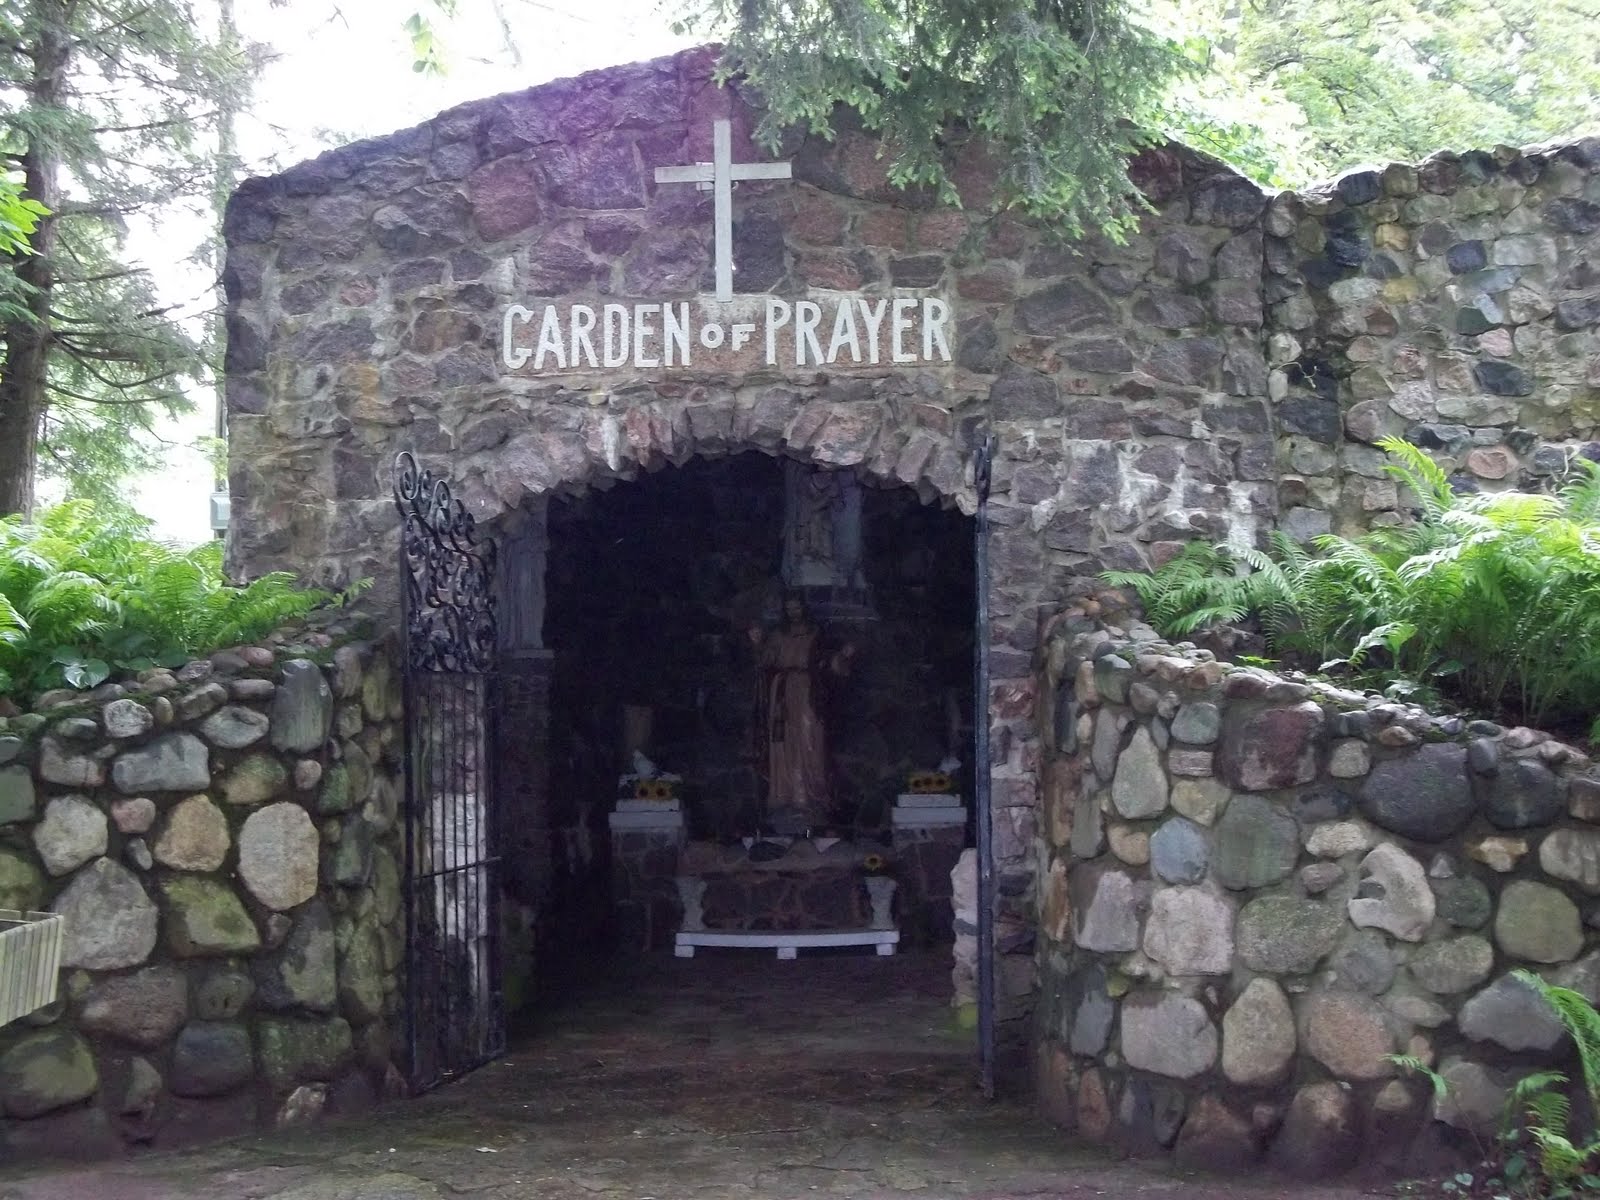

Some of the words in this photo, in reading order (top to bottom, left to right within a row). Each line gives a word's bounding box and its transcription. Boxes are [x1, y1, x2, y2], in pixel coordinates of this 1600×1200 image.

[502, 302, 691, 370] GARDEN
[700, 323, 756, 352] OF
[765, 298, 953, 366] PRAYER
